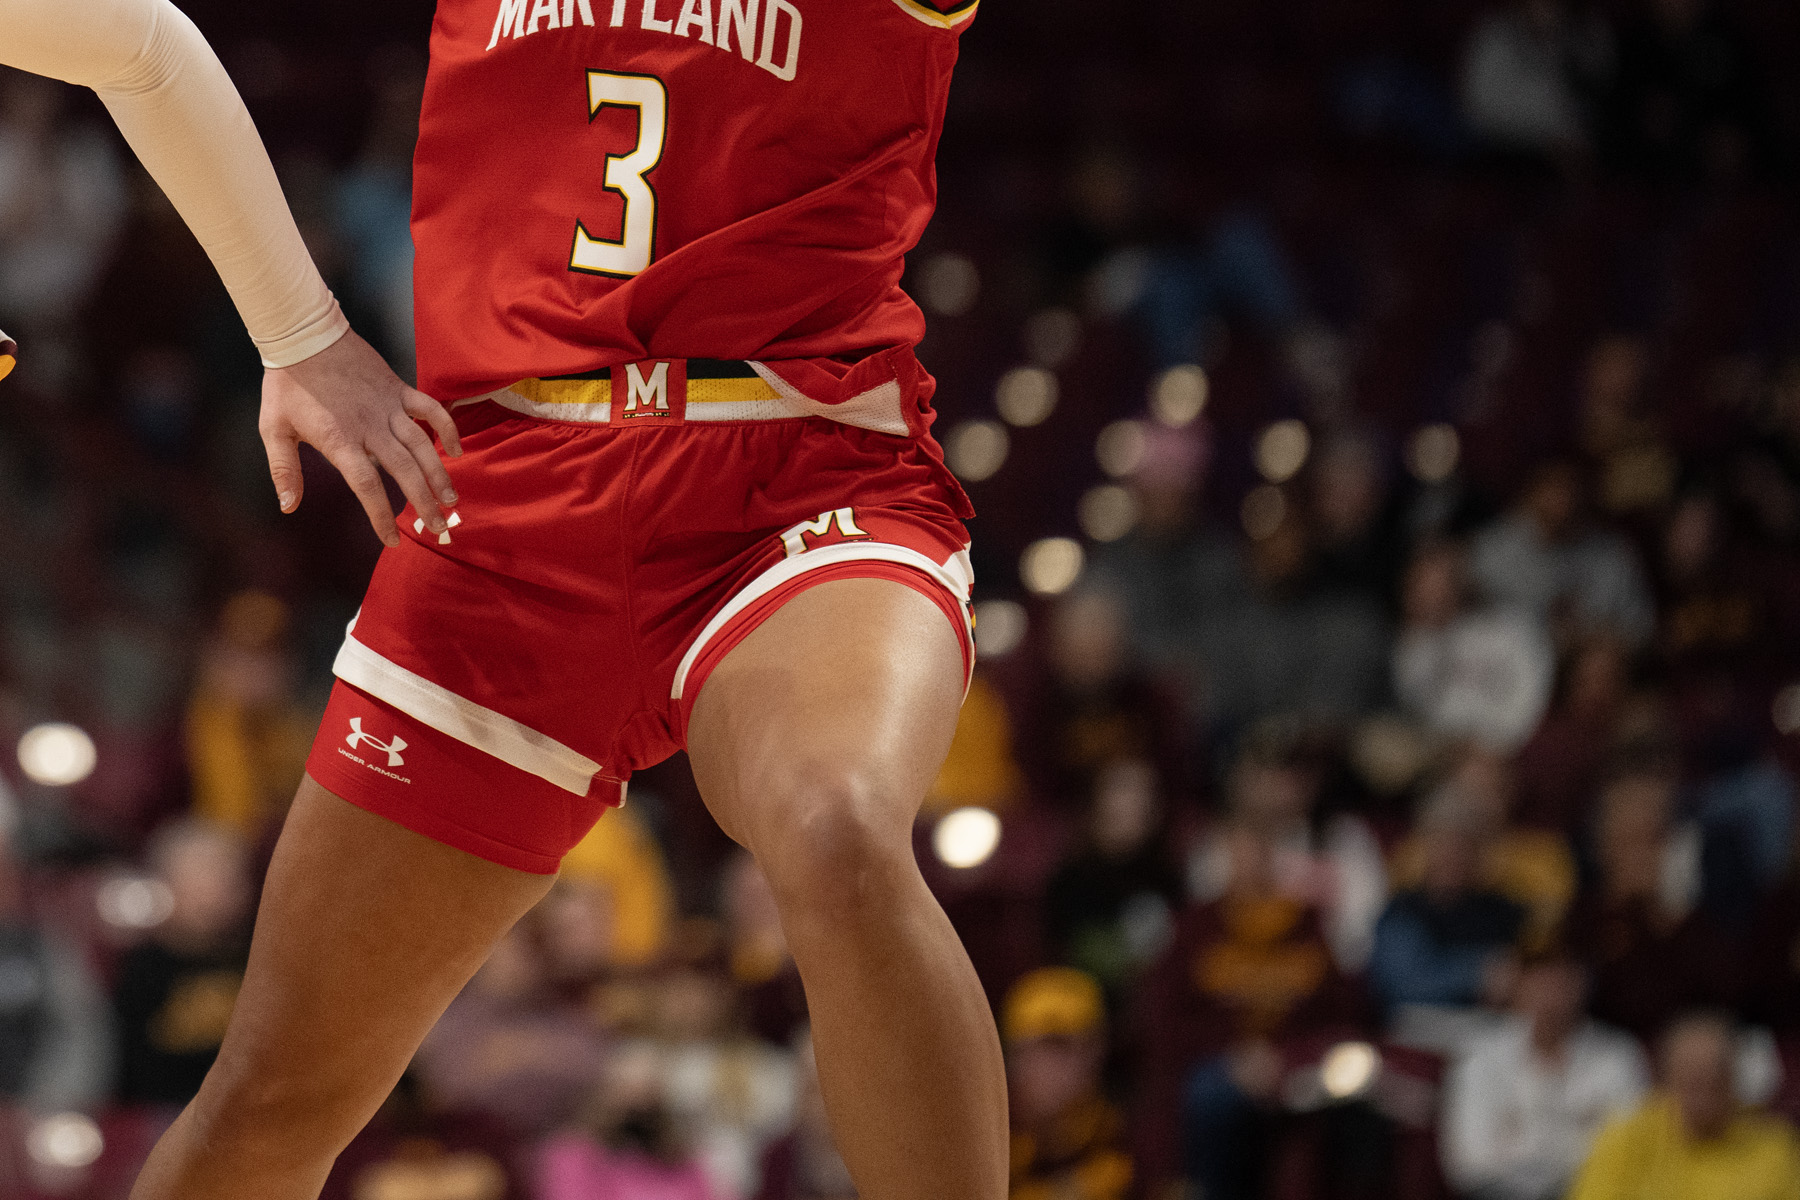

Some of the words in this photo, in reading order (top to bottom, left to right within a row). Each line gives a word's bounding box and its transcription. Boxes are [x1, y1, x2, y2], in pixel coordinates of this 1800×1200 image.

[567, 67, 669, 280] 3
[623, 361, 672, 412] M
[337, 747, 366, 766] UNDER
[366, 763, 412, 785] ARMOUR
